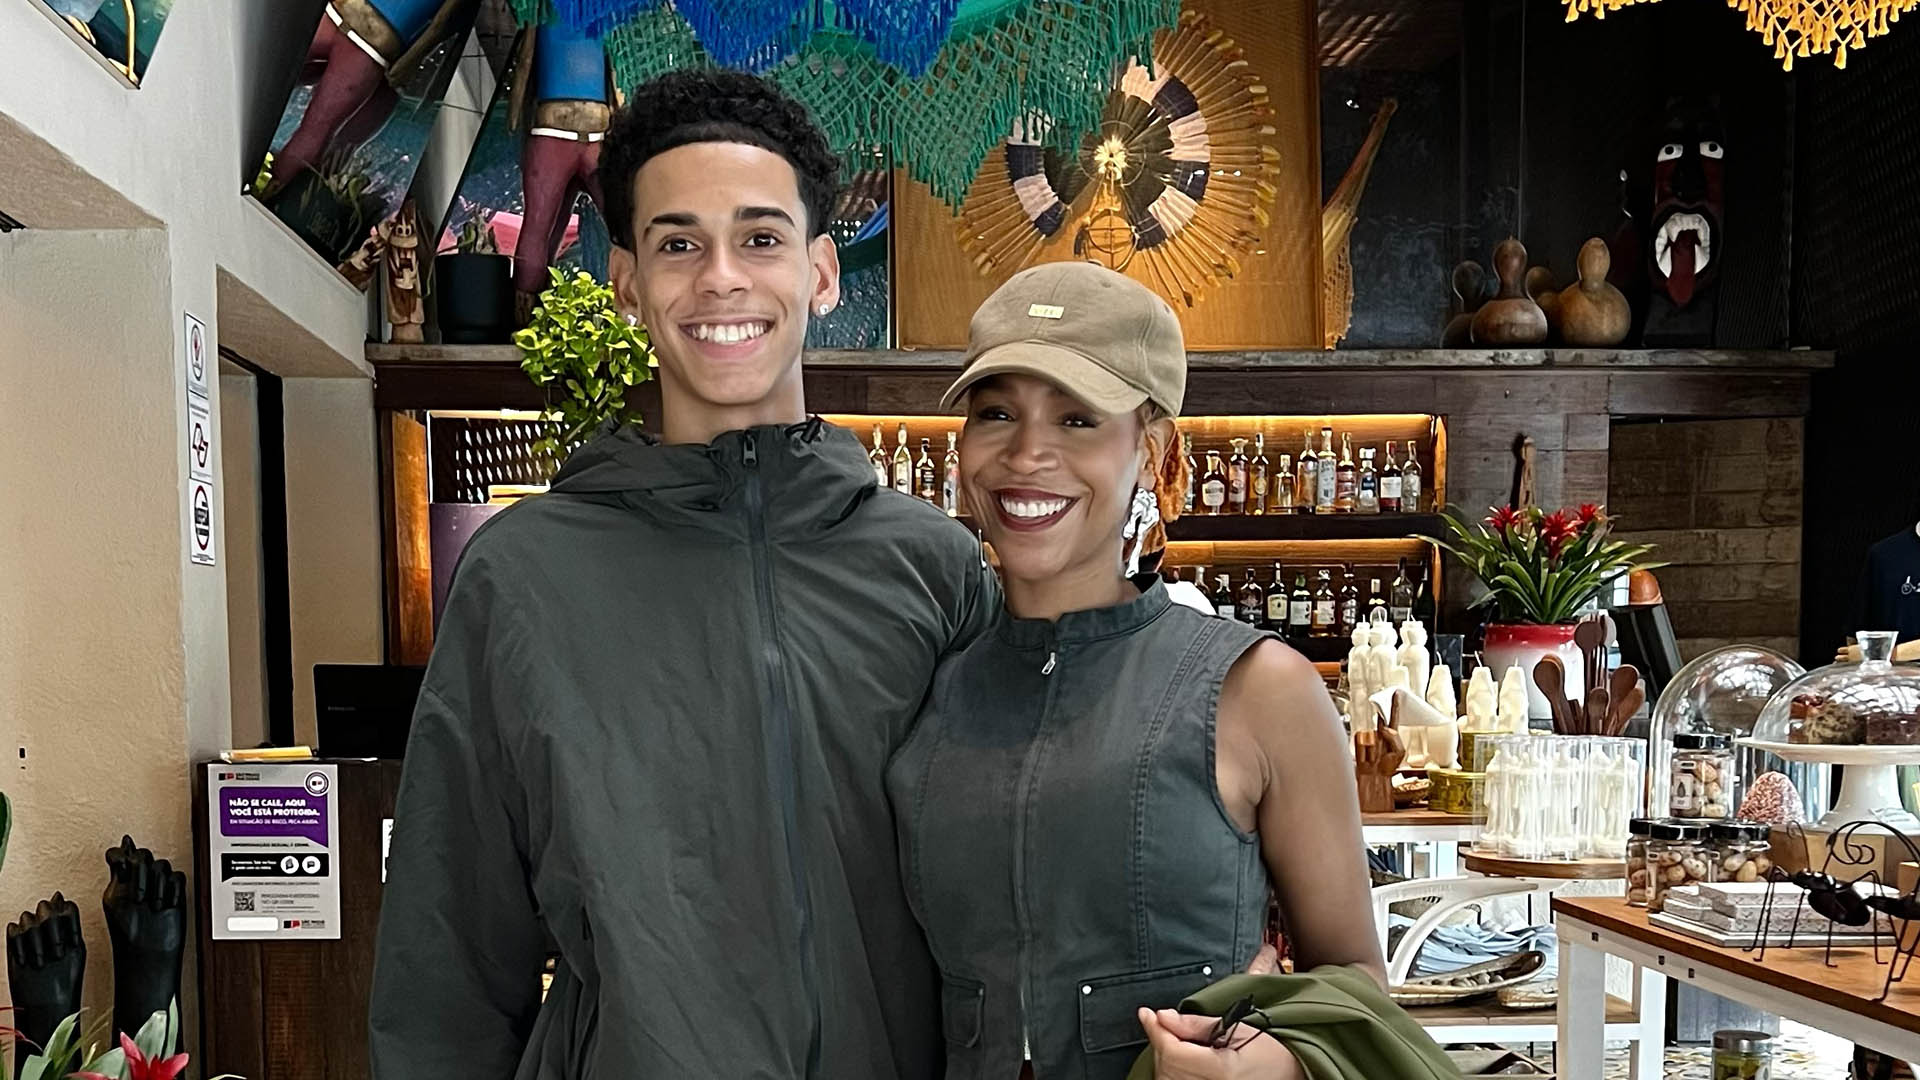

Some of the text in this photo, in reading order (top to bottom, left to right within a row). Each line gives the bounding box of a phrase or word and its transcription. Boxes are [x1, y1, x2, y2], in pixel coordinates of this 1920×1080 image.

[229, 798, 249, 807] NÃO
[230, 808, 251, 816] VOCÊ
[253, 808, 272, 816] ESTÁ
